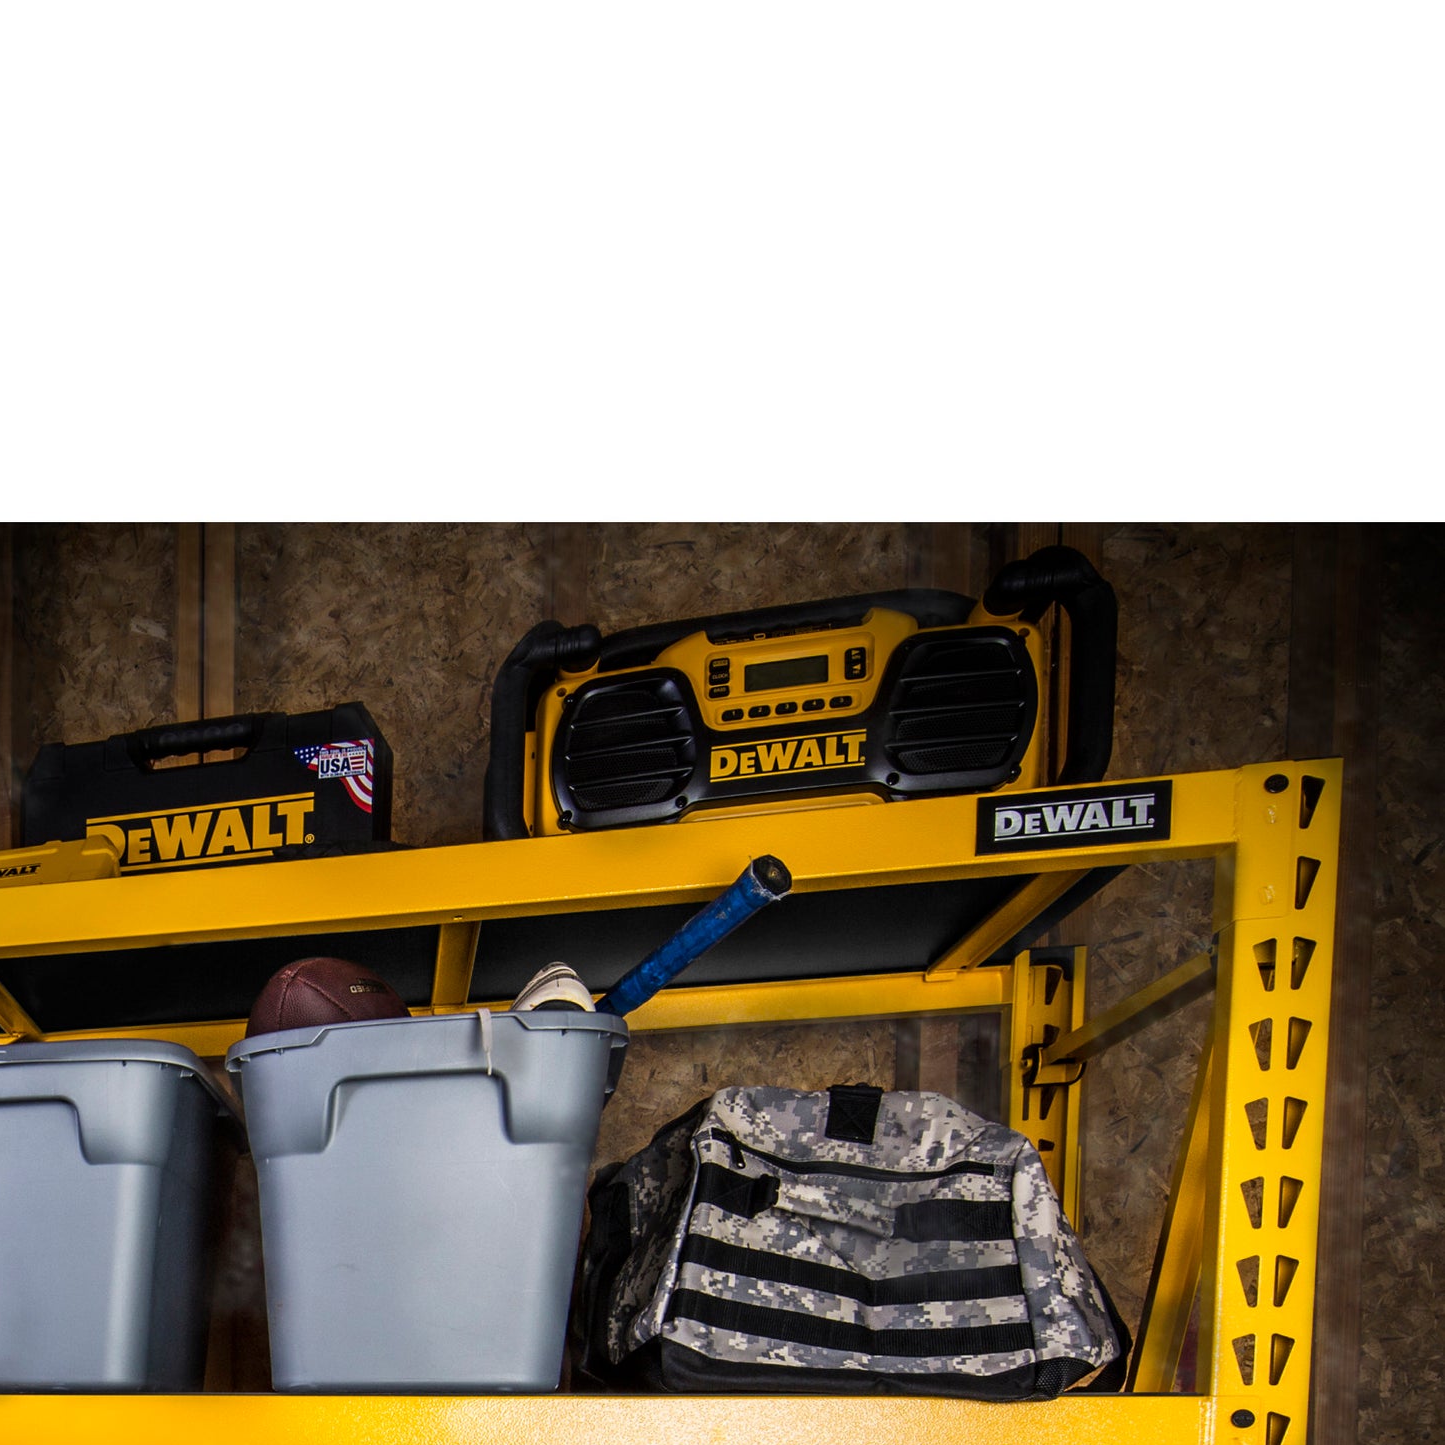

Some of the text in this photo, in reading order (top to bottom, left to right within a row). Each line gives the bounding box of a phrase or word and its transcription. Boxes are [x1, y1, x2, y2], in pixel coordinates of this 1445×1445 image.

[320, 757, 351, 774] USA
[710, 733, 867, 778] DEWALT
[995, 797, 1155, 837] DEWALT
